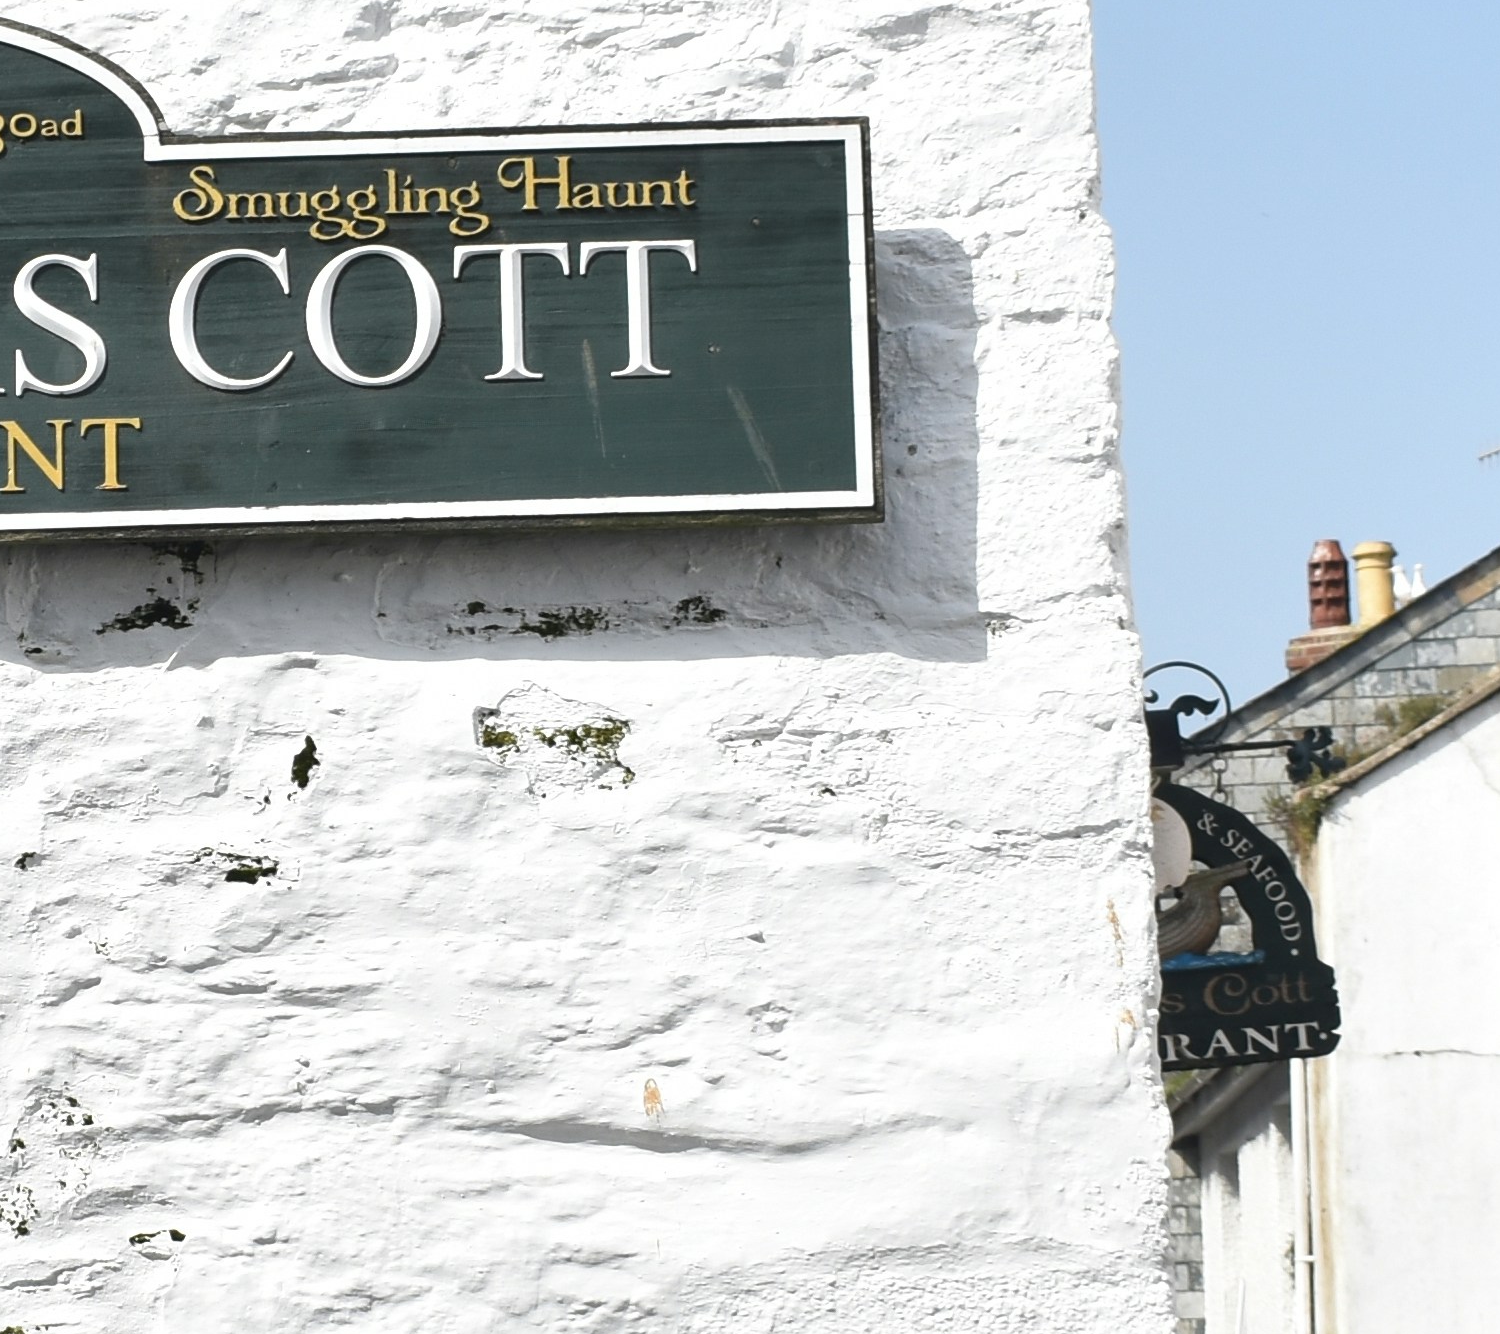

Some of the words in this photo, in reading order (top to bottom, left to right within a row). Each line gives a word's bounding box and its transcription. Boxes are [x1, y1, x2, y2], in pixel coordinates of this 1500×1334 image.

[172, 165, 490, 240] Smuggling
[497, 155, 696, 211] Haunt
[168, 239, 697, 392] COTT
[1197, 809, 1220, 836] &
[1219, 828, 1302, 942] SEAFOOD
[1203, 972, 1314, 1016] Cott
[1160, 1020, 1321, 1063] RANT
